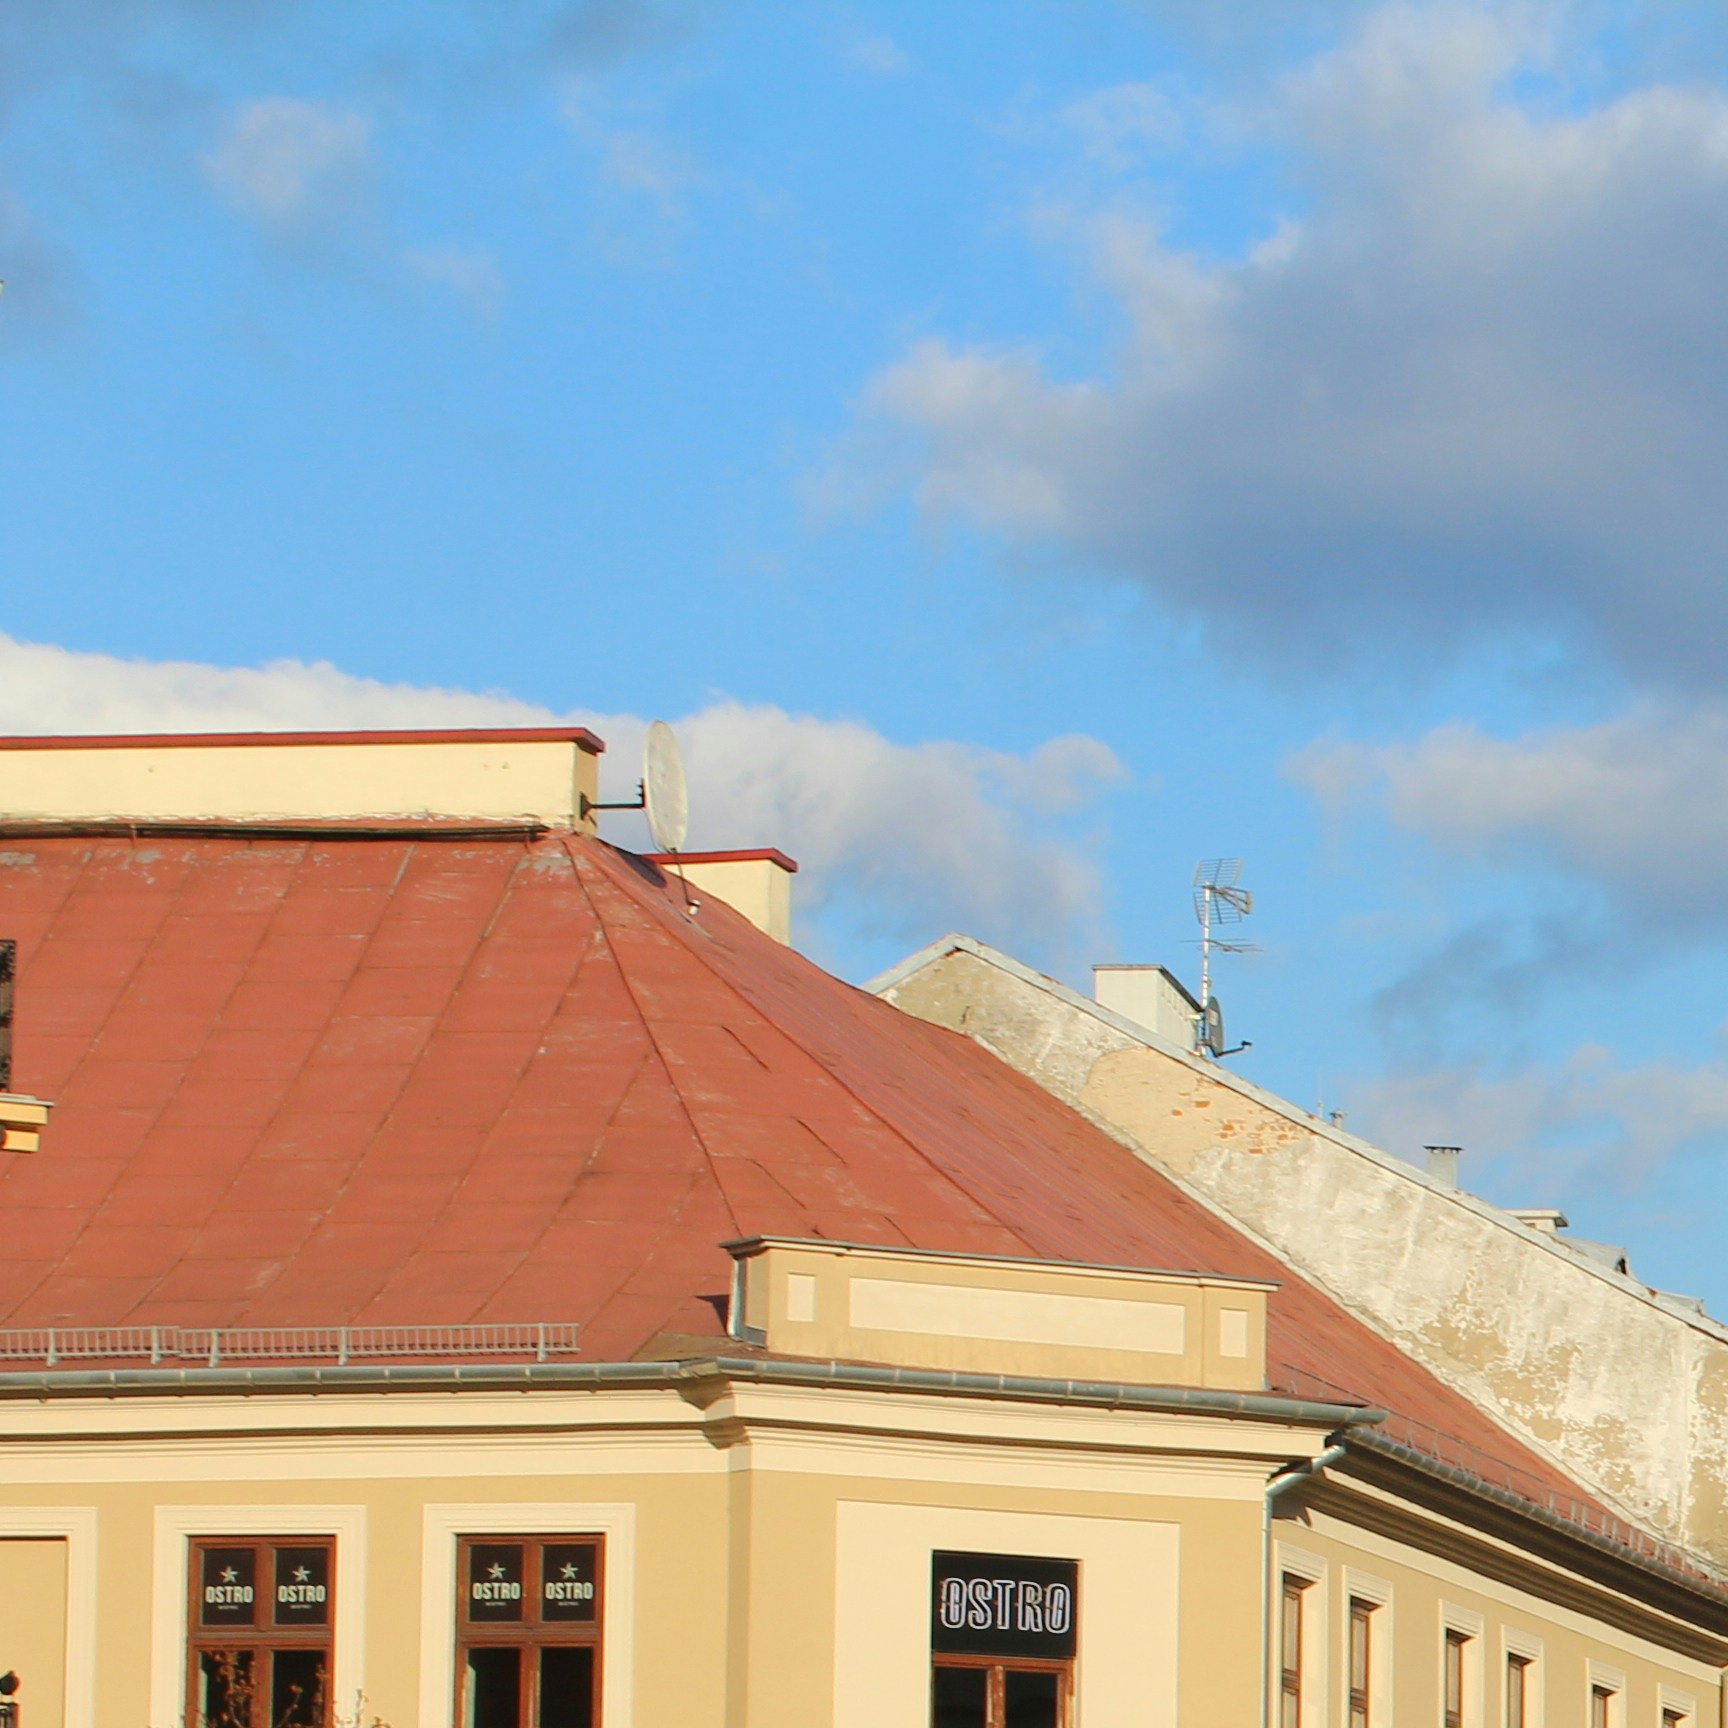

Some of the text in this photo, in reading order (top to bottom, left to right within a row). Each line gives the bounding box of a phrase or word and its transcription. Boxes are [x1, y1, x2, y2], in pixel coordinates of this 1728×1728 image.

[205, 1585, 253, 1603] OSTRO
[277, 1585, 326, 1603] OSTRO
[472, 1582, 520, 1599] OSTRO
[545, 1582, 593, 1599] OSTRO
[940, 1576, 1071, 1634] OSTRO
